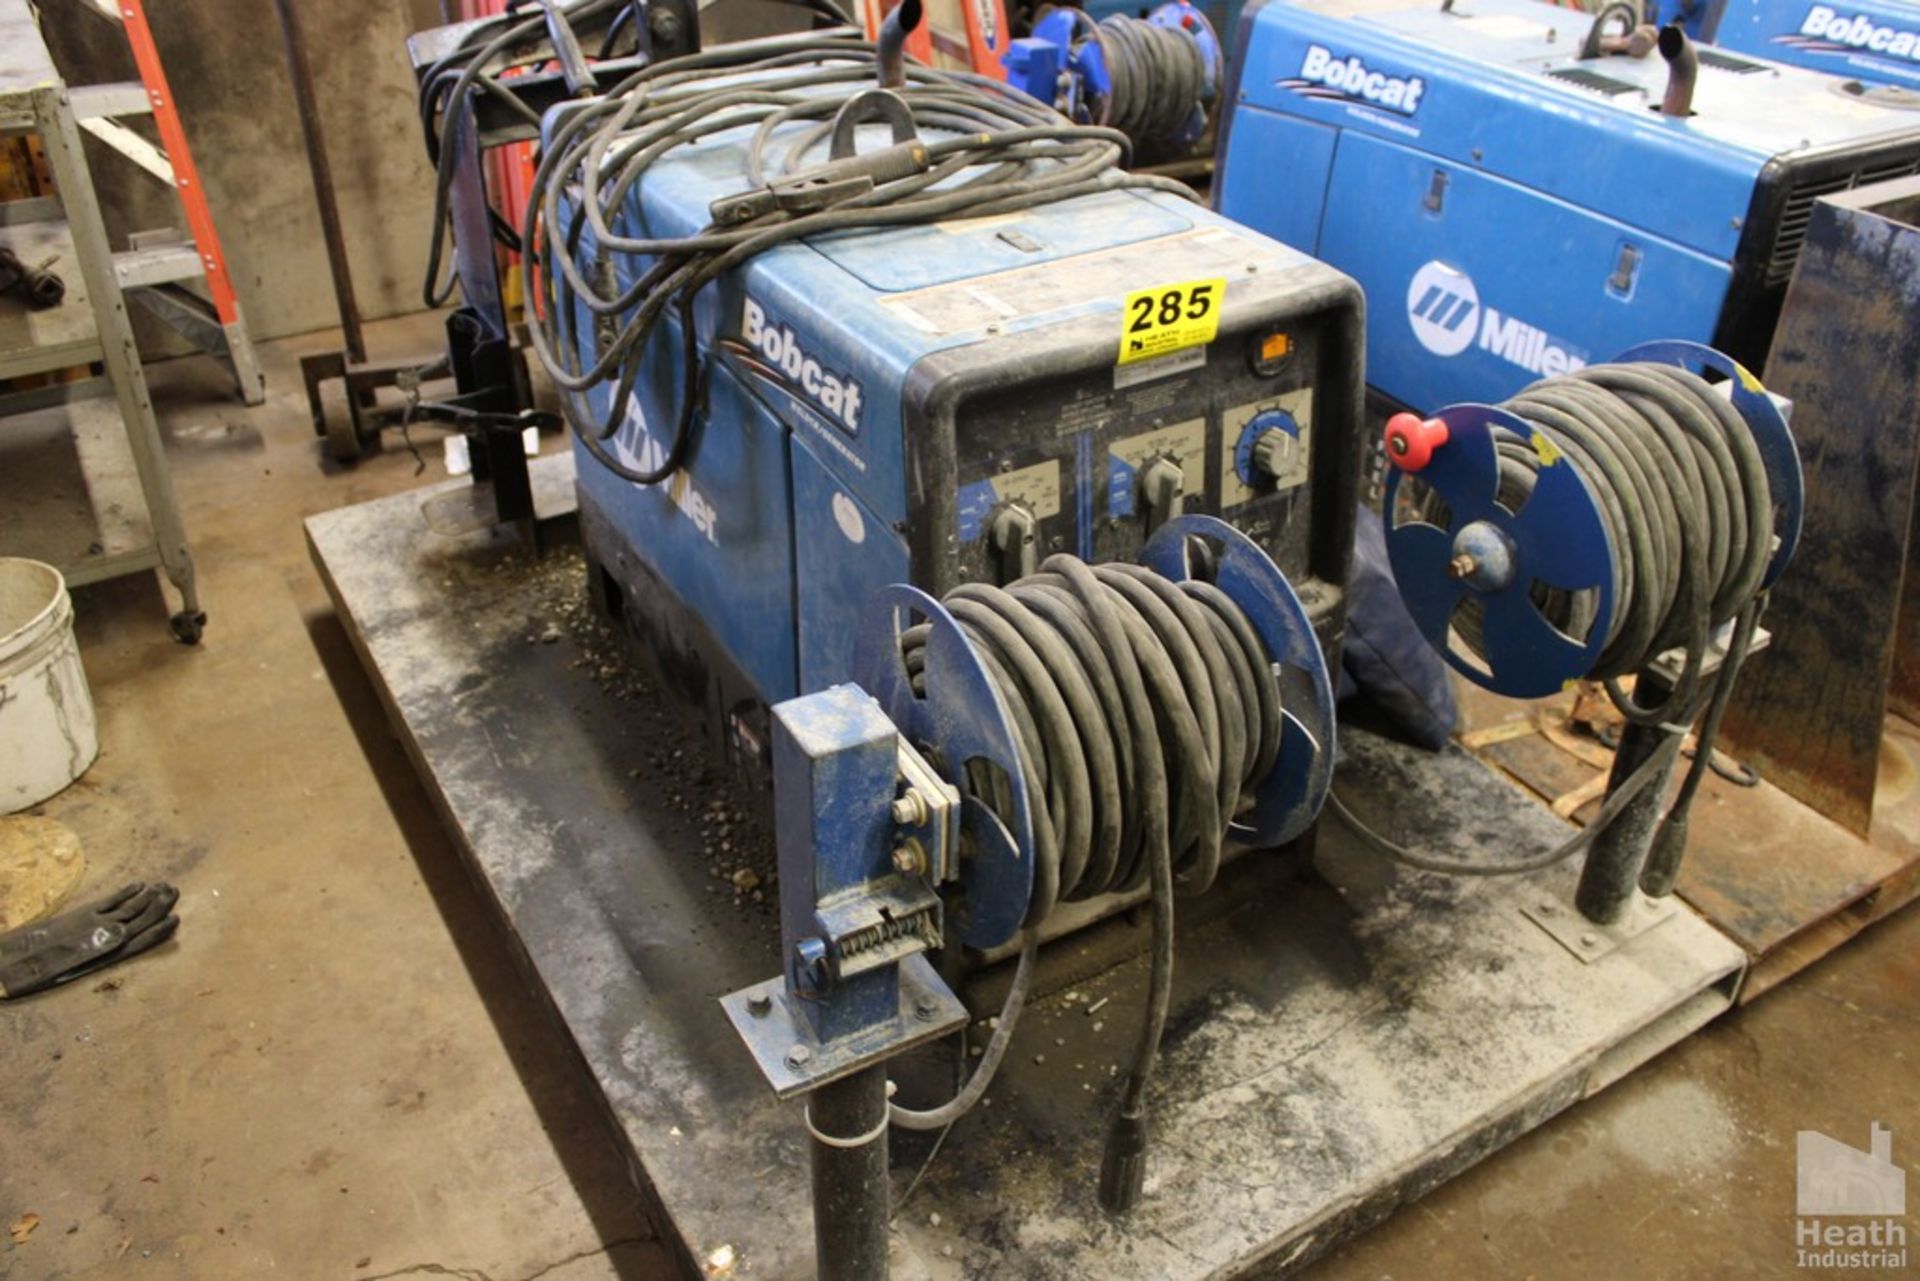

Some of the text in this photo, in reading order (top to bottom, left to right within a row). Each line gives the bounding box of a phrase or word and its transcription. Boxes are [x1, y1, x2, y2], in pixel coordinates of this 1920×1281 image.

[1301, 44, 1423, 113] Bobcat
[1129, 285, 1213, 334] 285
[741, 296, 863, 430] Bobcat
